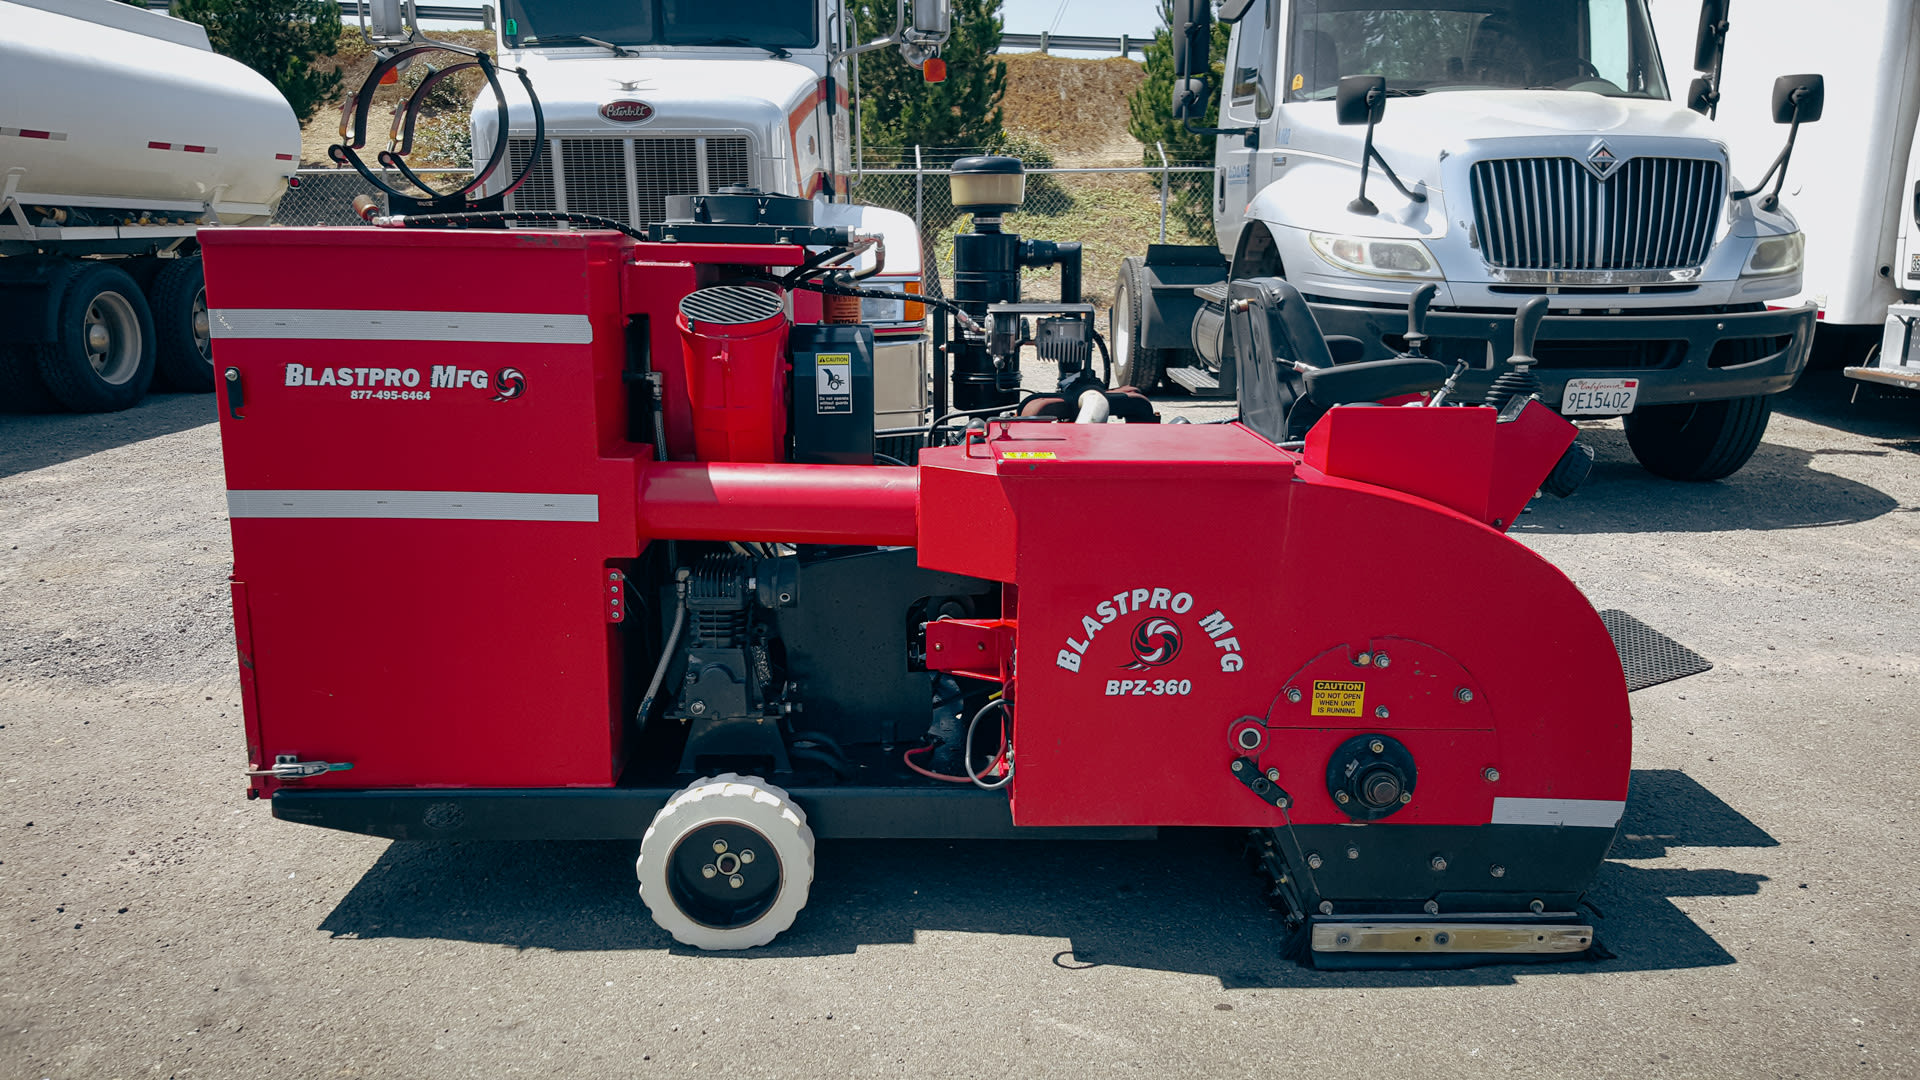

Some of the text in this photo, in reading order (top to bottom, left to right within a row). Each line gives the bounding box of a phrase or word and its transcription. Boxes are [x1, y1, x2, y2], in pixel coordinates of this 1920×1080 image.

[606, 104, 649, 117] Peterbilt
[285, 363, 489, 389] BLASTPRO MFG
[1579, 382, 1622, 391] California
[350, 390, 431, 401] 877-495-6464
[1567, 391, 1631, 409] 9E15402
[1056, 587, 1244, 673] BLASTPRO MFG
[1105, 679, 1192, 696] BPZ-360
[1317, 682, 1361, 690] CAUTION
[1327, 692, 1341, 700] NOT
